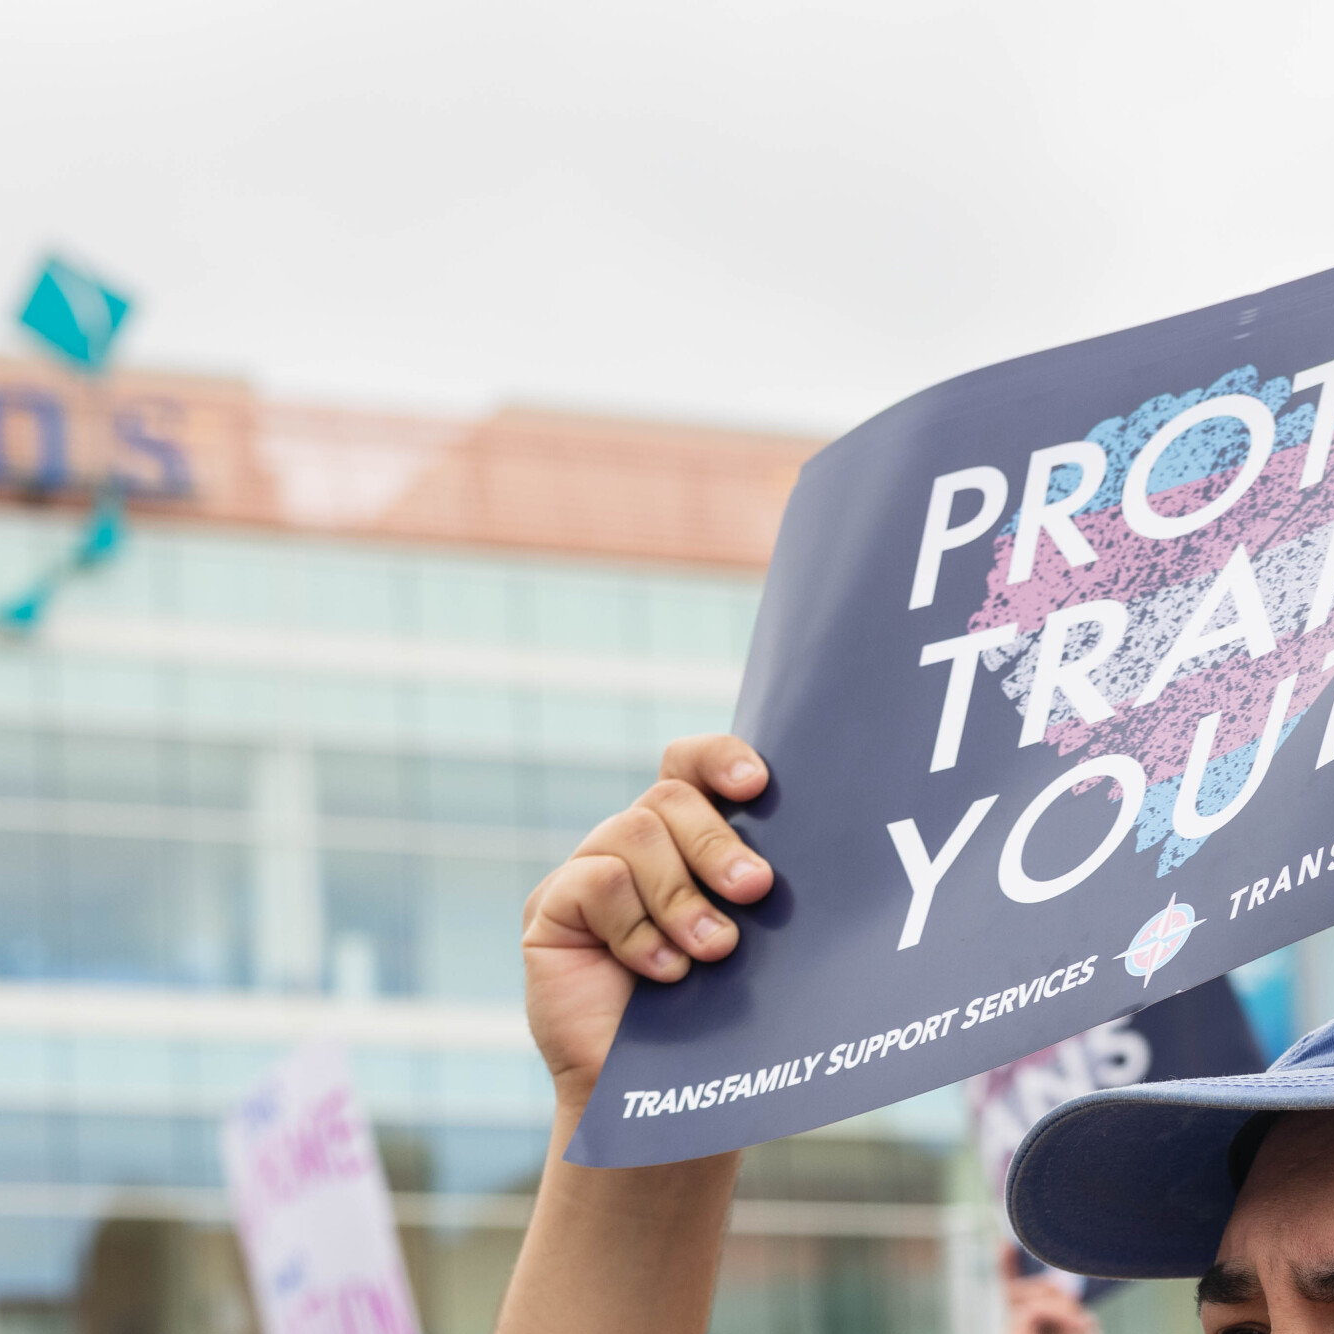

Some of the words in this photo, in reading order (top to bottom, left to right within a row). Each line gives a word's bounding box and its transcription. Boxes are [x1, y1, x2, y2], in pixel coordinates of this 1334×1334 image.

[622, 1051, 825, 1119] TRANSFAMILY
[824, 1007, 960, 1076] SUPPORT
[960, 954, 1098, 1030] SERVICES
